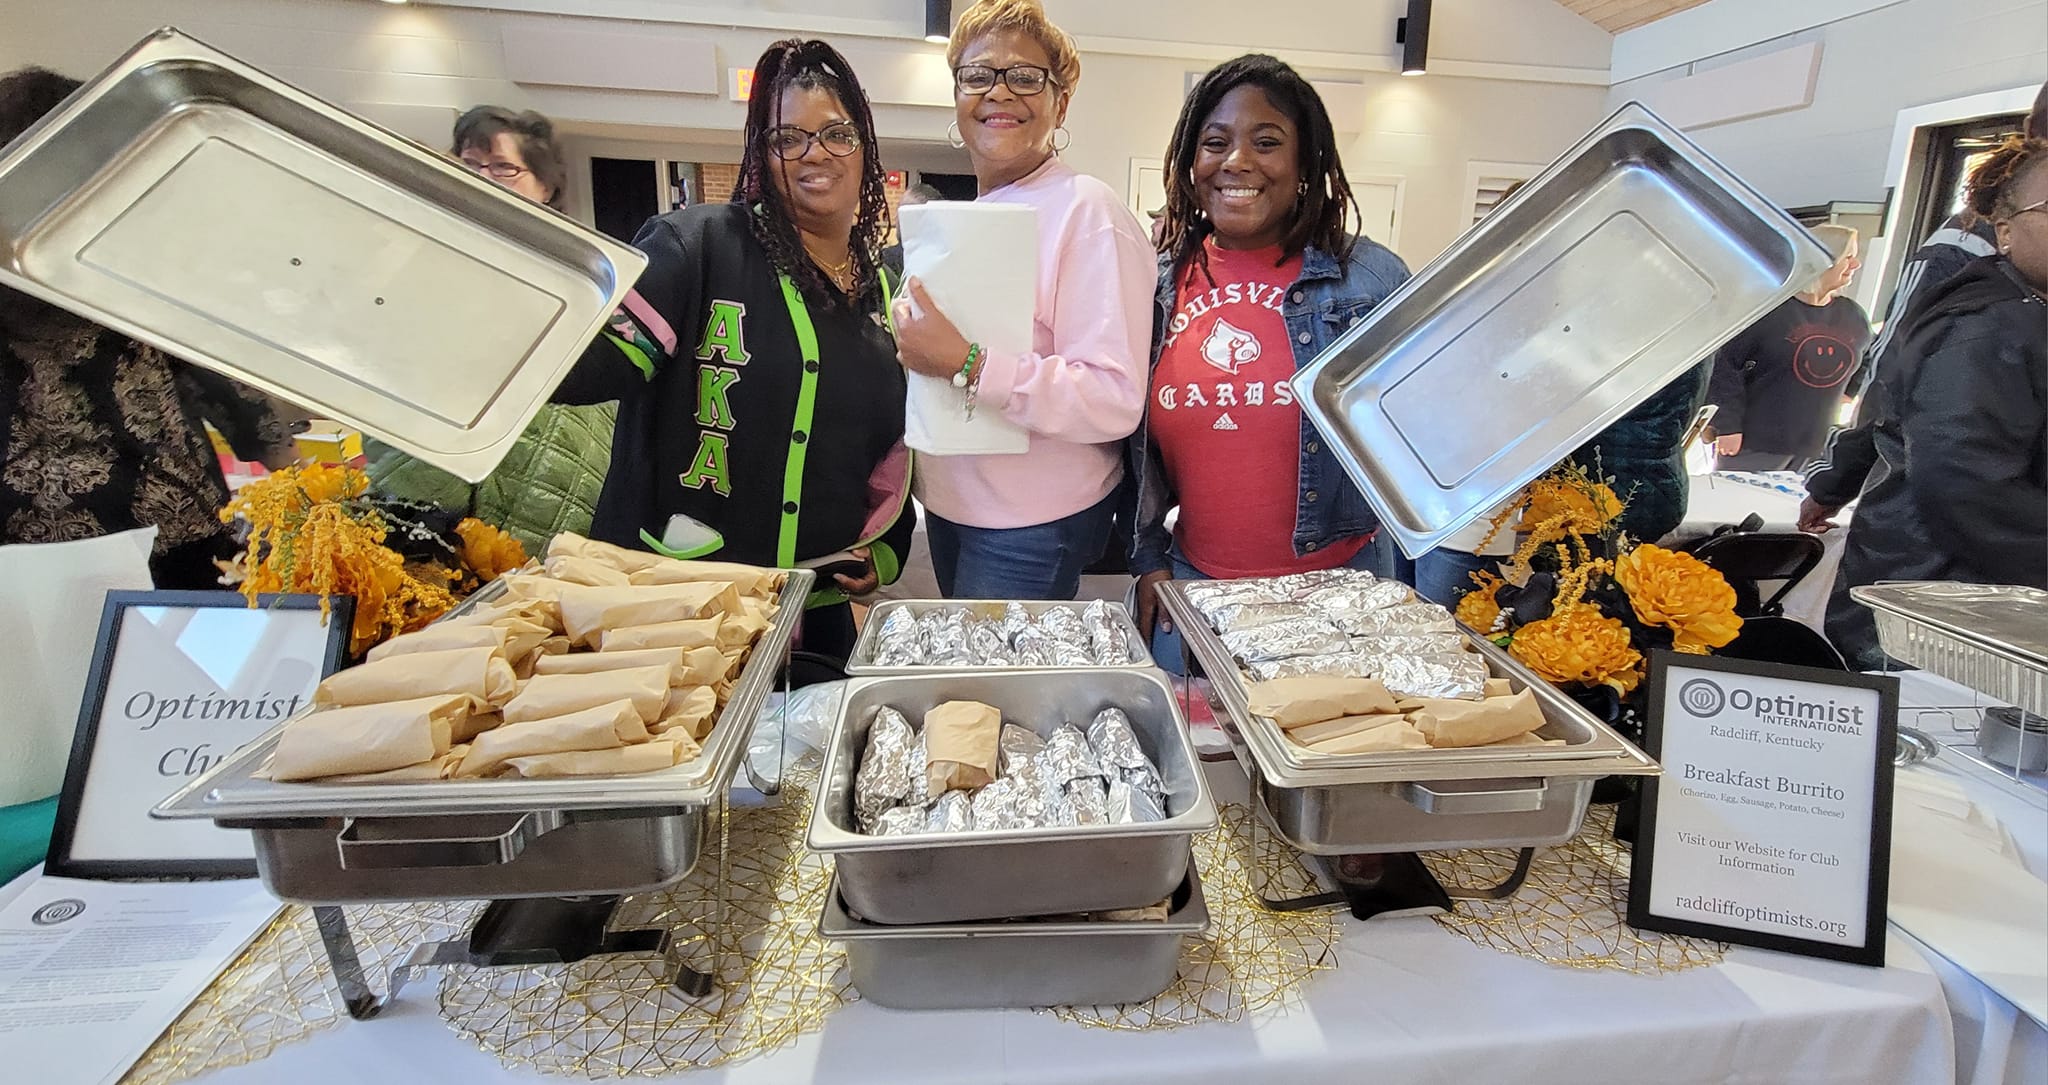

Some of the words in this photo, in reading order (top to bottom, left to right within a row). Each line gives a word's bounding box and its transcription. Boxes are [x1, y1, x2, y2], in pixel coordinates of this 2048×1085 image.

[679, 299, 751, 497] AKA
[1158, 381, 1293, 410] CARDS
[124, 691, 303, 731] Optimist
[1729, 689, 1864, 726] Optimist
[1762, 715, 1862, 736] INTERNATIONAL
[1710, 725, 1761, 744] Radcliff,
[1765, 732, 1824, 752] Kentucky
[1683, 763, 1771, 791] Breakfast
[1776, 776, 1845, 801] Burrito
[1740, 796, 1777, 810] Sausage,
[1779, 802, 1809, 815] Potato,
[1810, 806, 1845, 819] Cheese)
[1678, 831, 1706, 846] Visit
[1709, 838, 1731, 850] our
[1735, 840, 1785, 859] Website
[1788, 848, 1807, 862] for
[1810, 852, 1839, 867] Club
[1718, 854, 1795, 876] Information
[1675, 895, 1847, 937] radcliffoptimists.org
